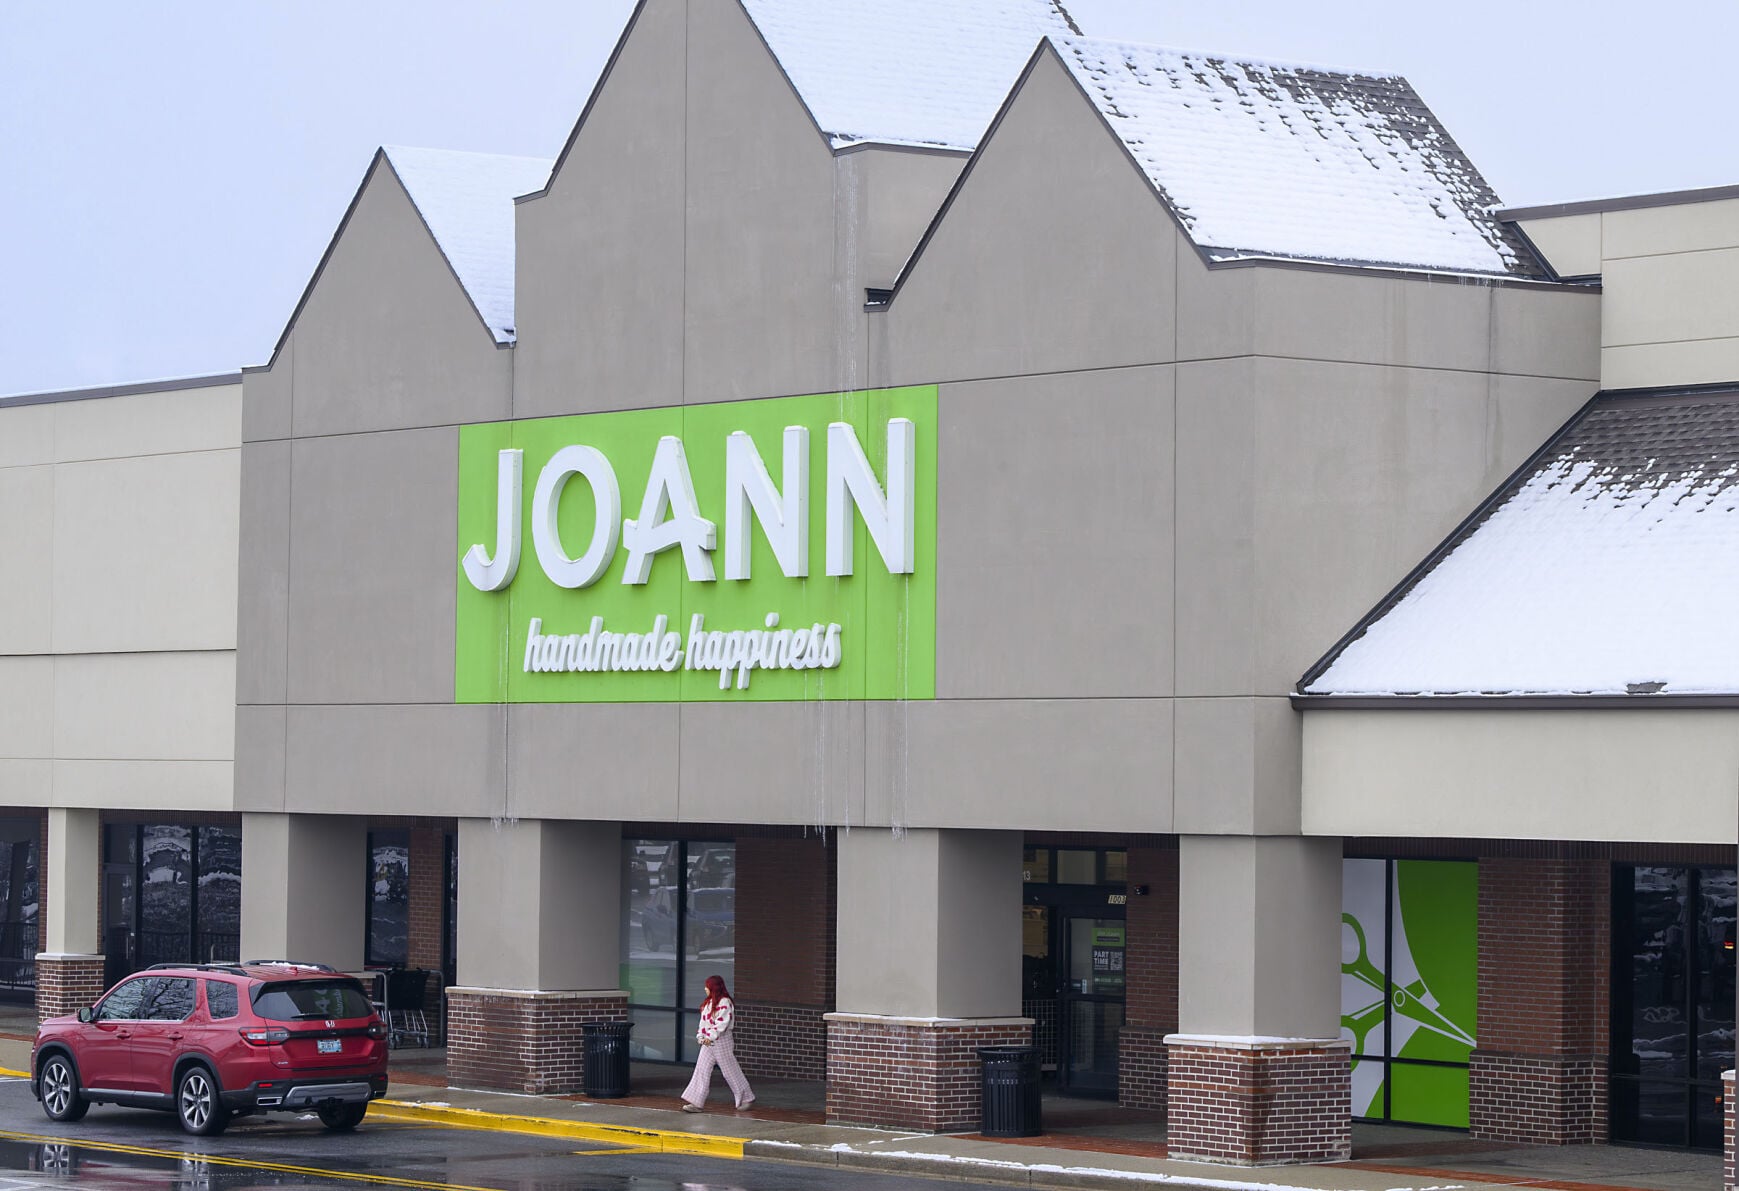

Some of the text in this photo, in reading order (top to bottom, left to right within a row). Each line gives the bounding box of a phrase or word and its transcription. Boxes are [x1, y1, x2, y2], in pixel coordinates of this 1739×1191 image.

[462, 418, 915, 592] JOANN
[523, 612, 841, 690] handmade happiness
[1093, 950, 1109, 958] PART
